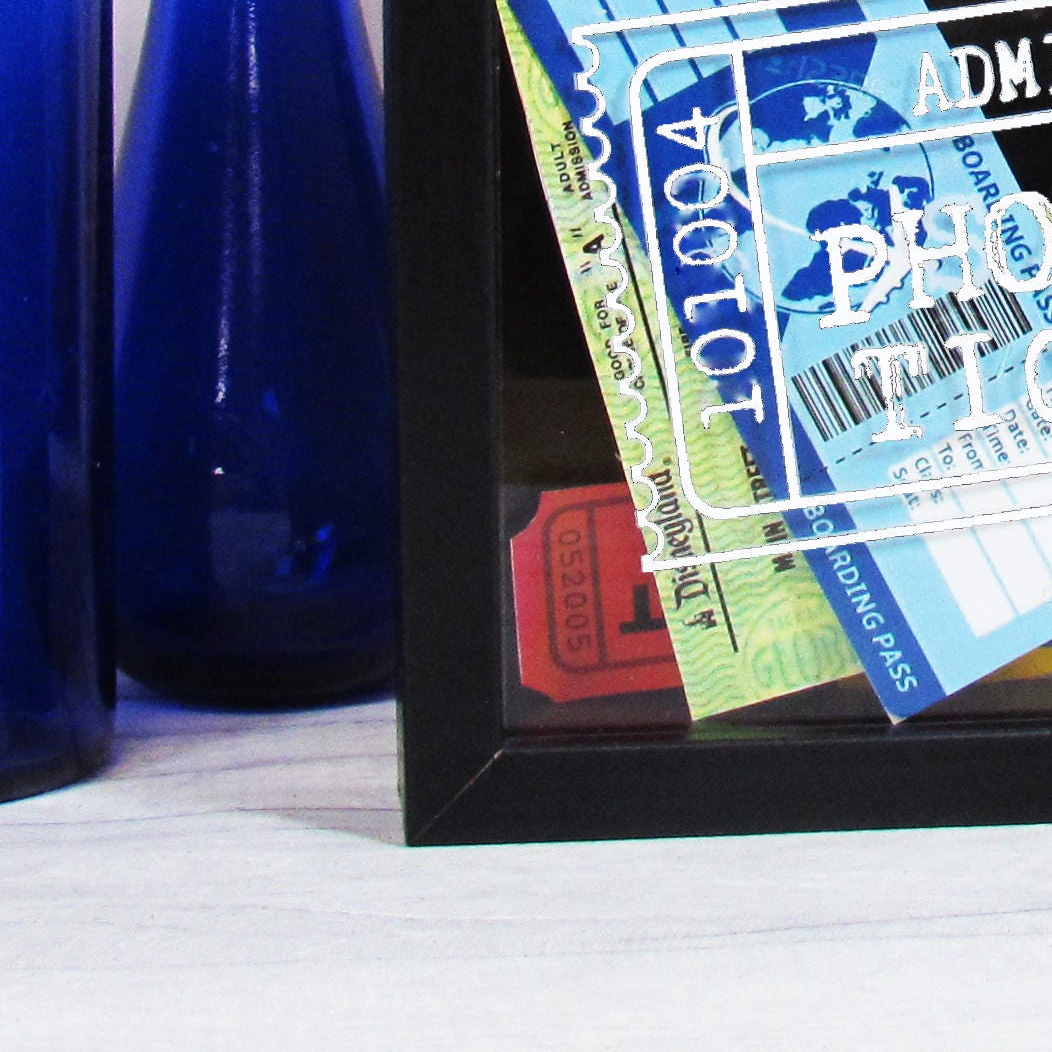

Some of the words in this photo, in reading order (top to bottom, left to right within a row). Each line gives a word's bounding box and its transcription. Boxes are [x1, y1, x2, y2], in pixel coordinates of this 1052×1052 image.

[550, 142, 575, 193] ADULT
[562, 120, 593, 201] ADMISSION
[952, 134, 1033, 263] BOARING
[655, 106, 766, 430] 101004
[937, 441, 956, 470] To:
[1003, 408, 1030, 454] Date:
[763, 520, 797, 573] MIN
[872, 631, 918, 694] PASS
